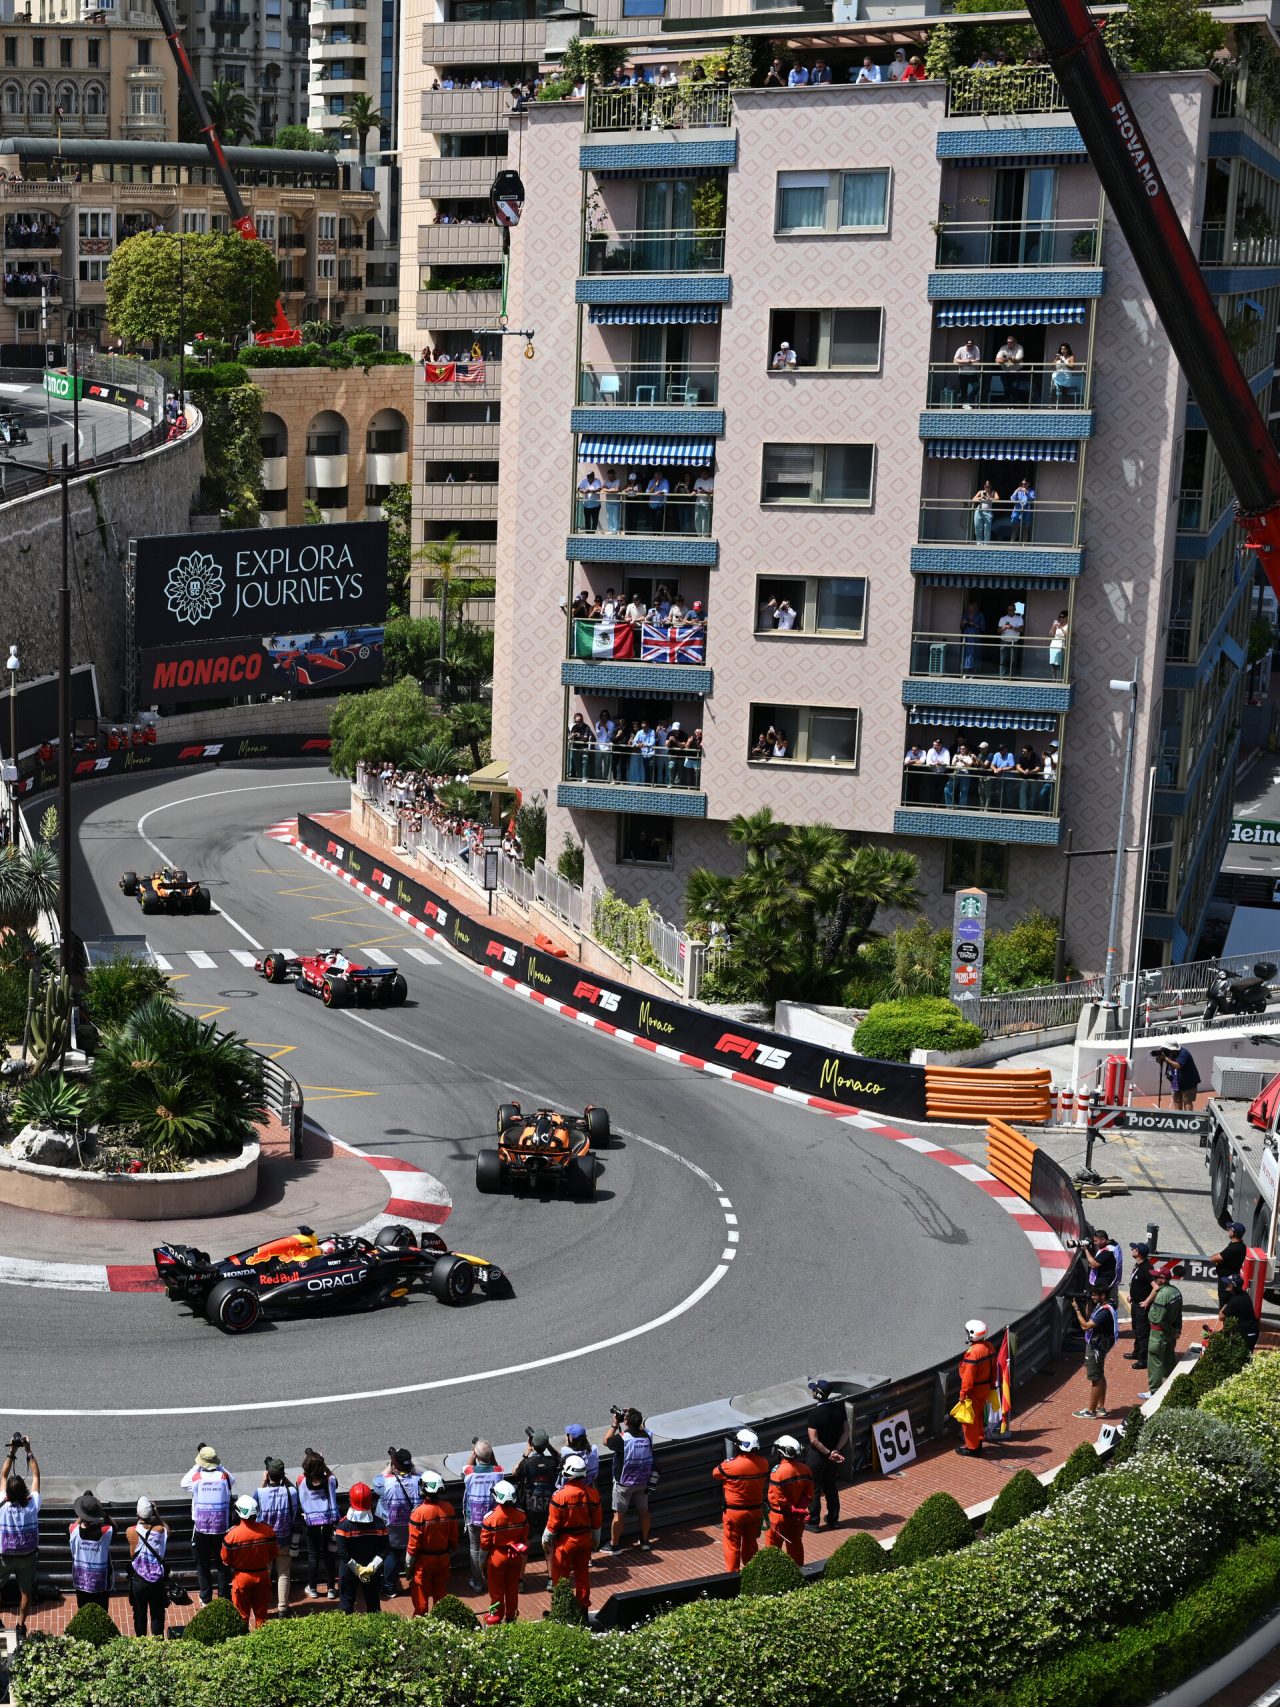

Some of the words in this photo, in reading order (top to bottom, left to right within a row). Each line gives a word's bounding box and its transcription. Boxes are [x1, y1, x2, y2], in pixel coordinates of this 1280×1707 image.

[1111, 101, 1160, 197] PIOVANO
[236, 543, 354, 578] EXPLORA
[232, 573, 363, 617] JOURNEYS
[153, 653, 263, 689] MONACO
[1229, 824, 1280, 843] Hein
[639, 1001, 675, 1035] Monaco
[820, 1058, 885, 1096] Monaco
[1128, 1116, 1201, 1131] PIOVANO
[222, 1268, 256, 1278] HONDA
[259, 1274, 279, 1285] Red
[280, 1271, 300, 1283] Bull
[307, 1269, 368, 1291] ORACLE
[880, 1421, 911, 1463] SC
